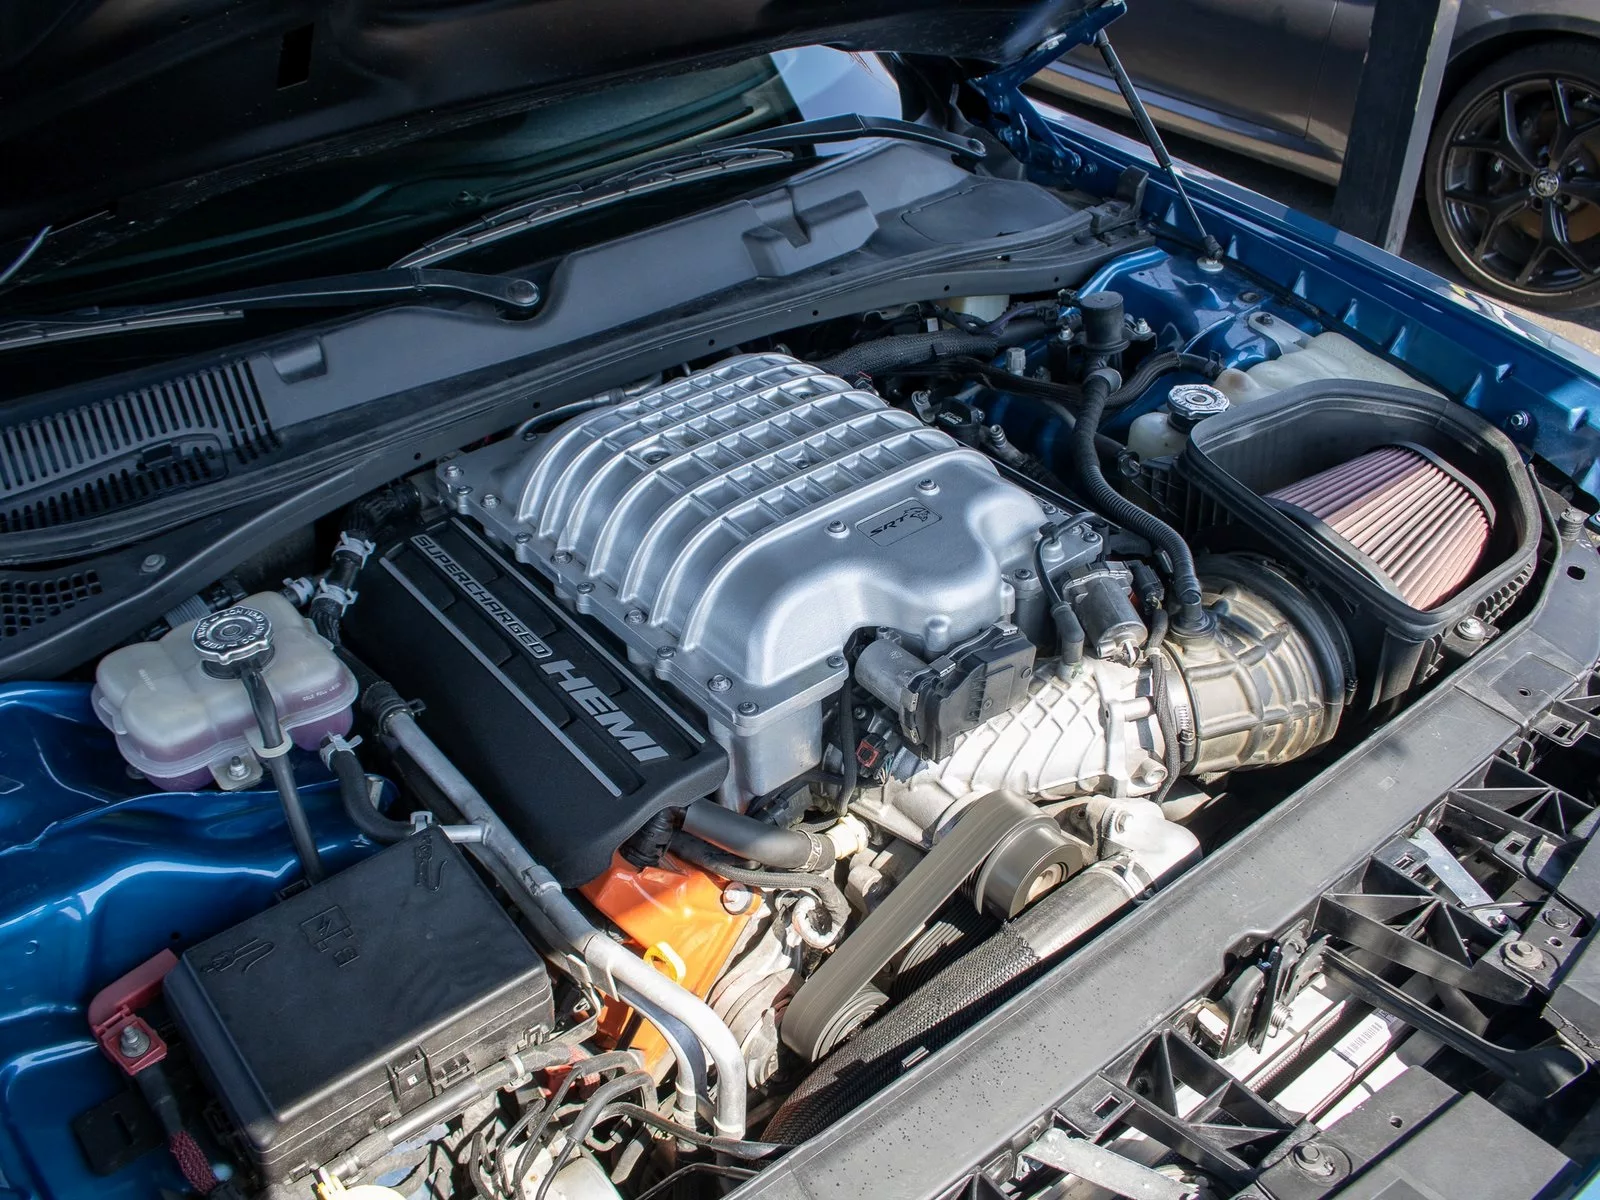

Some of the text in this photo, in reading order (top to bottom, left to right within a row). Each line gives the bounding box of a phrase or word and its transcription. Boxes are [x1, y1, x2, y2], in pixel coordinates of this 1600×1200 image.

[869, 513, 907, 537] SRT
[201, 640, 225, 650] KEEP
[223, 608, 243, 617] HOT
[412, 535, 669, 763] SUPERCHARGED HEMI
